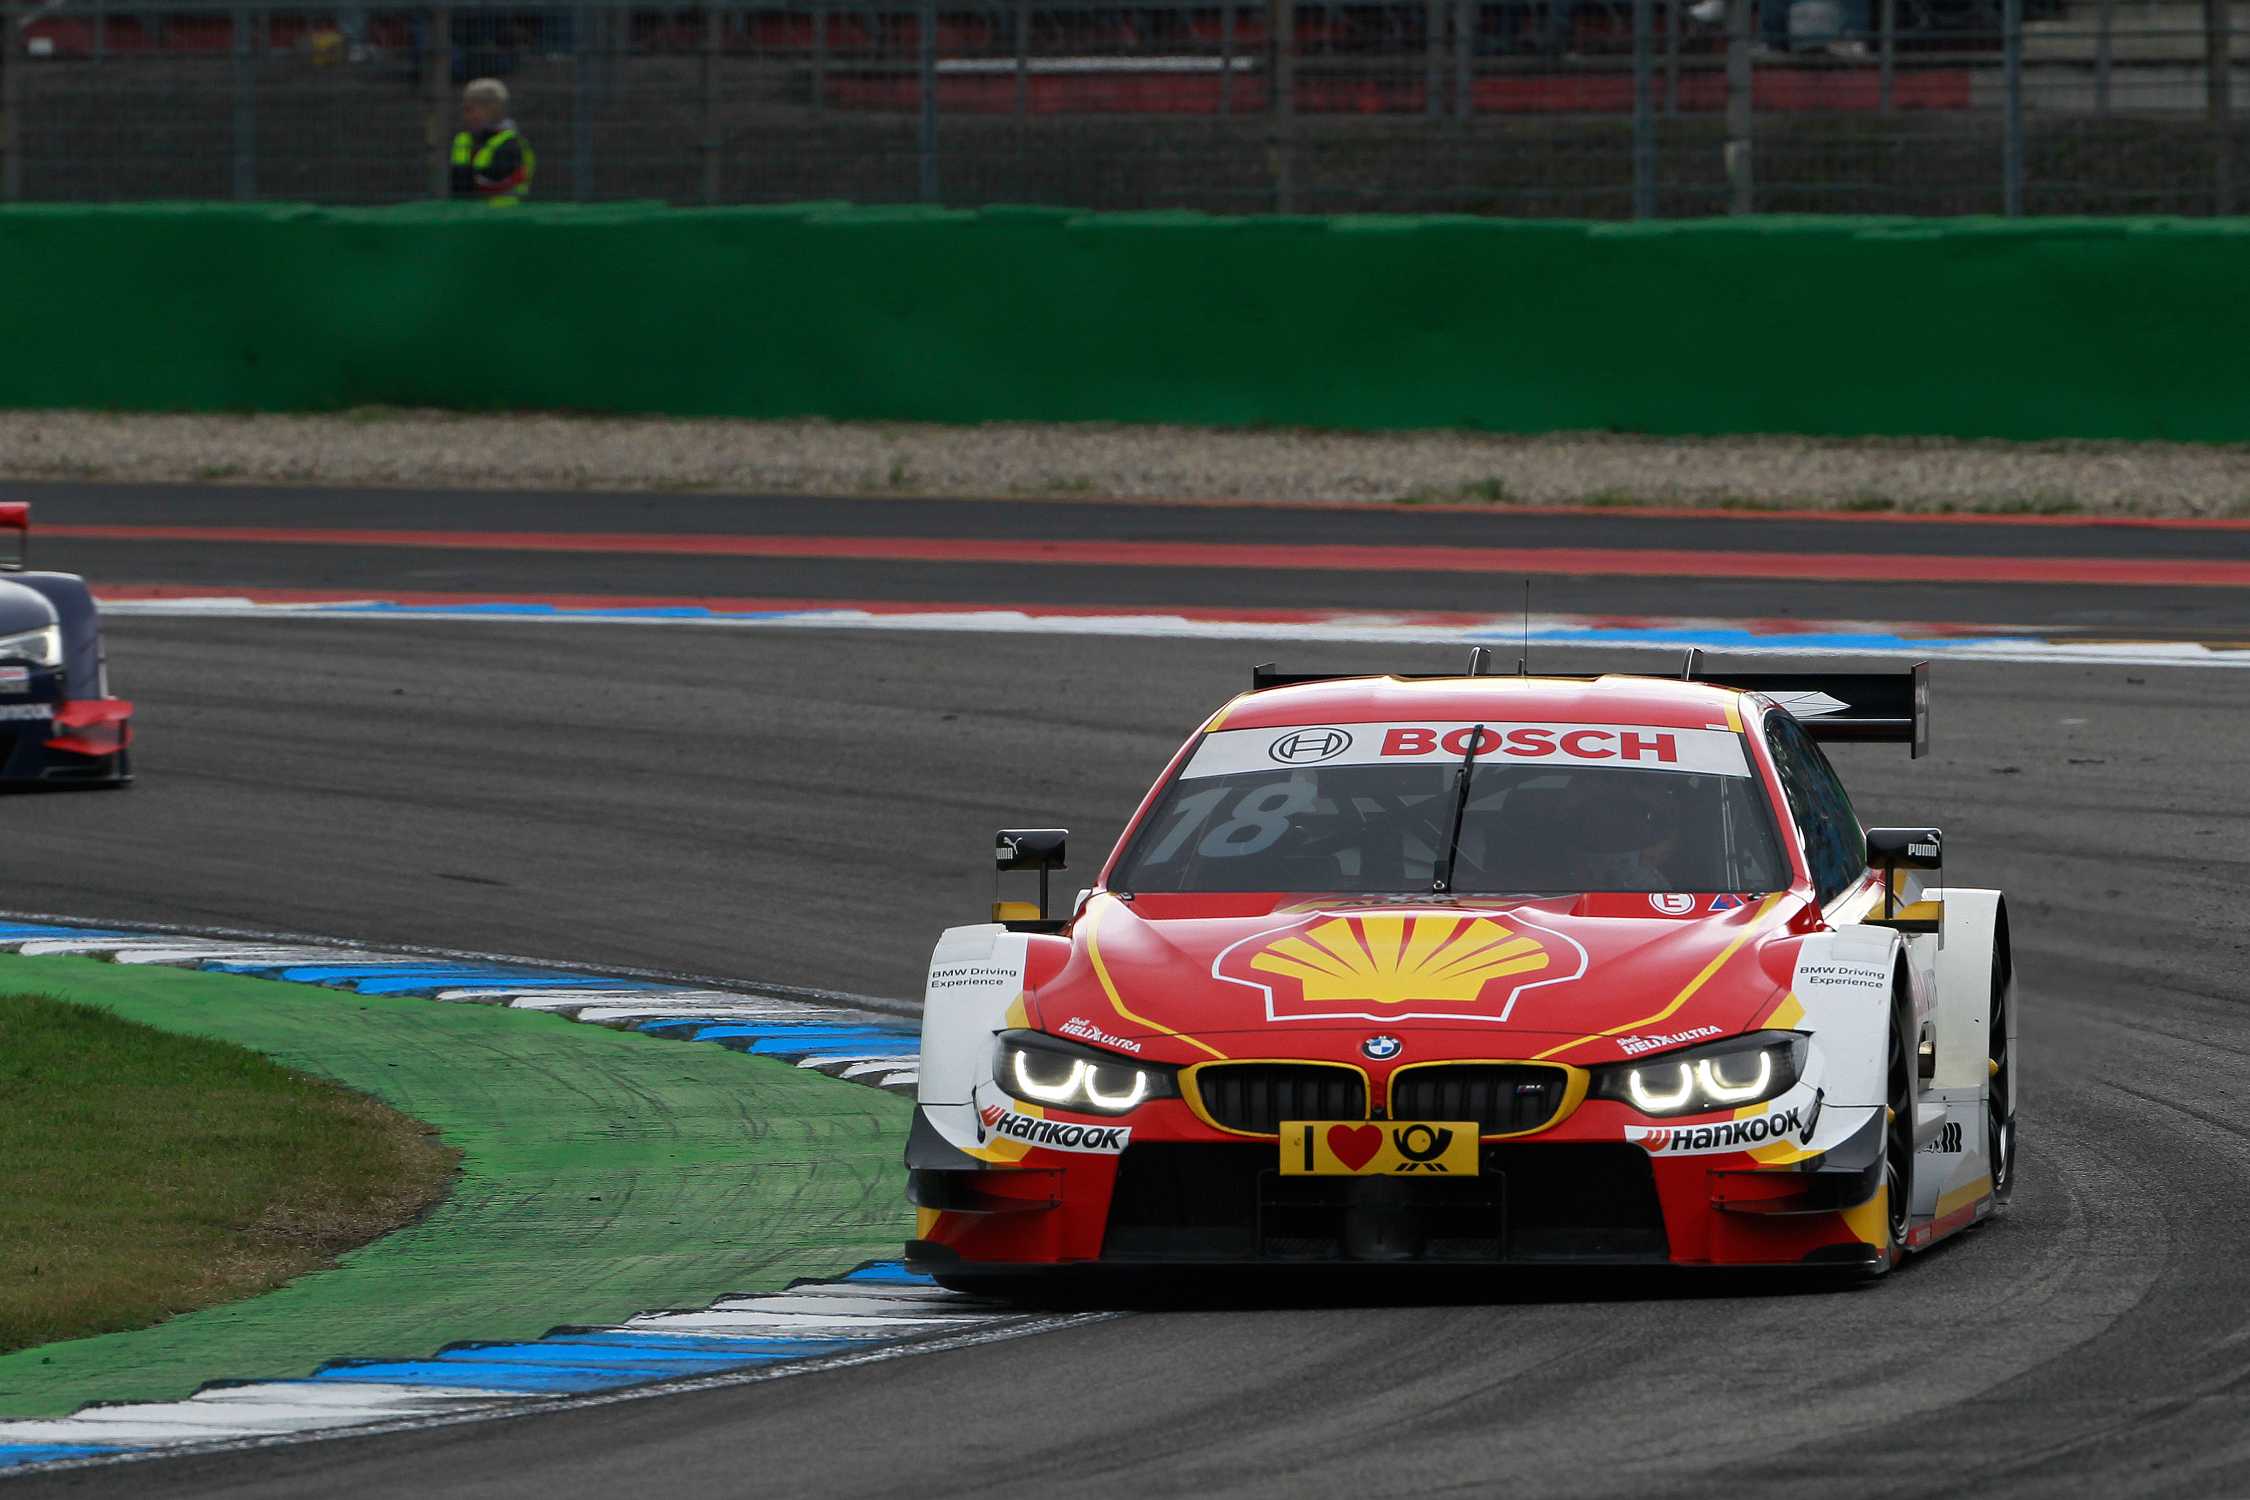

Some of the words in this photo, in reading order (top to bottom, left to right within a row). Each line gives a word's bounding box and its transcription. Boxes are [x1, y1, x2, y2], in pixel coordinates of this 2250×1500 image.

[1380, 728, 1678, 763] BOSCH
[1143, 782, 1319, 866] 18
[995, 847, 1014, 860] UMA
[1907, 843, 1937, 857] PUMA
[932, 968, 968, 979] BMW
[970, 967, 1018, 977] Driving
[1800, 966, 1836, 975] BMW
[1838, 967, 1886, 980] Driving
[931, 978, 1004, 989] Experience
[1809, 976, 1884, 989] Experience
[1058, 1022, 1102, 1042] HELIX
[1100, 1034, 1142, 1053] ULTRA
[1621, 1035, 1673, 1055] HELIX
[1671, 1024, 1723, 1043] ULTRA
[1304, 1125, 1314, 1172] I
